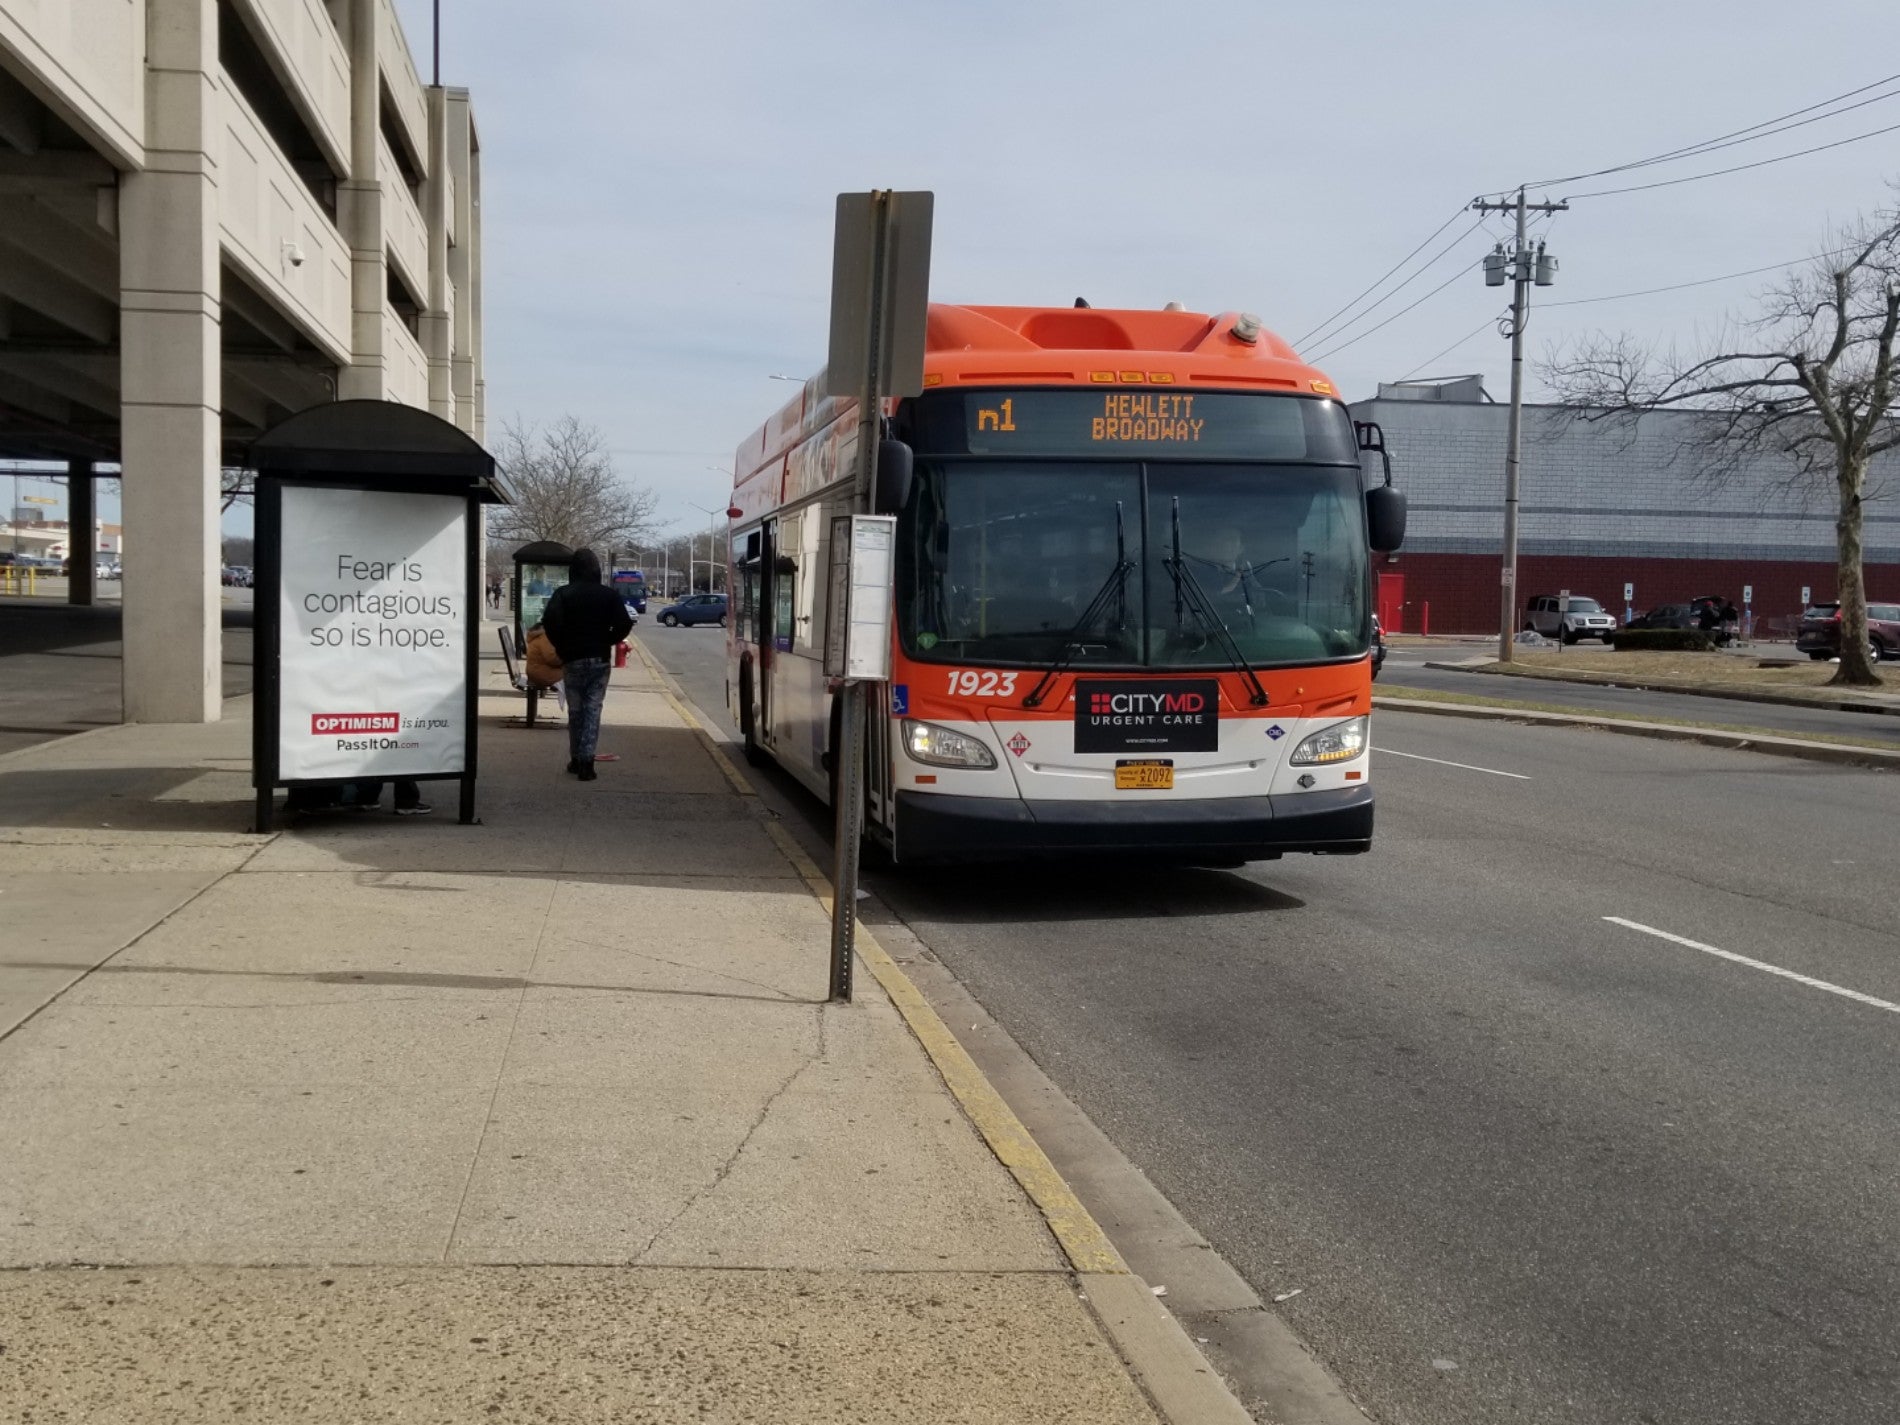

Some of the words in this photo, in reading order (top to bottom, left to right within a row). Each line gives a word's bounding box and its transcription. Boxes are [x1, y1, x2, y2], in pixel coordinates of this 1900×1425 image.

[977, 399, 1016, 431] n1
[1105, 395, 1194, 418] HEWLETT
[1092, 417, 1204, 441] BROADWAY
[338, 554, 397, 581] Fear
[403, 557, 422, 582] is
[304, 590, 456, 620] contagious,
[310, 627, 344, 647] so
[351, 622, 372, 647] is
[379, 622, 450, 652] hope.
[947, 671, 1018, 697] 1923
[1111, 693, 1204, 713] CITYMD
[316, 717, 395, 731] OPTIMISM
[402, 718, 413, 729] is
[414, 717, 426, 729] in
[1091, 715, 1155, 725] URGENT
[1163, 714, 1203, 724] CARE
[337, 738, 419, 751] PassItOn.com
